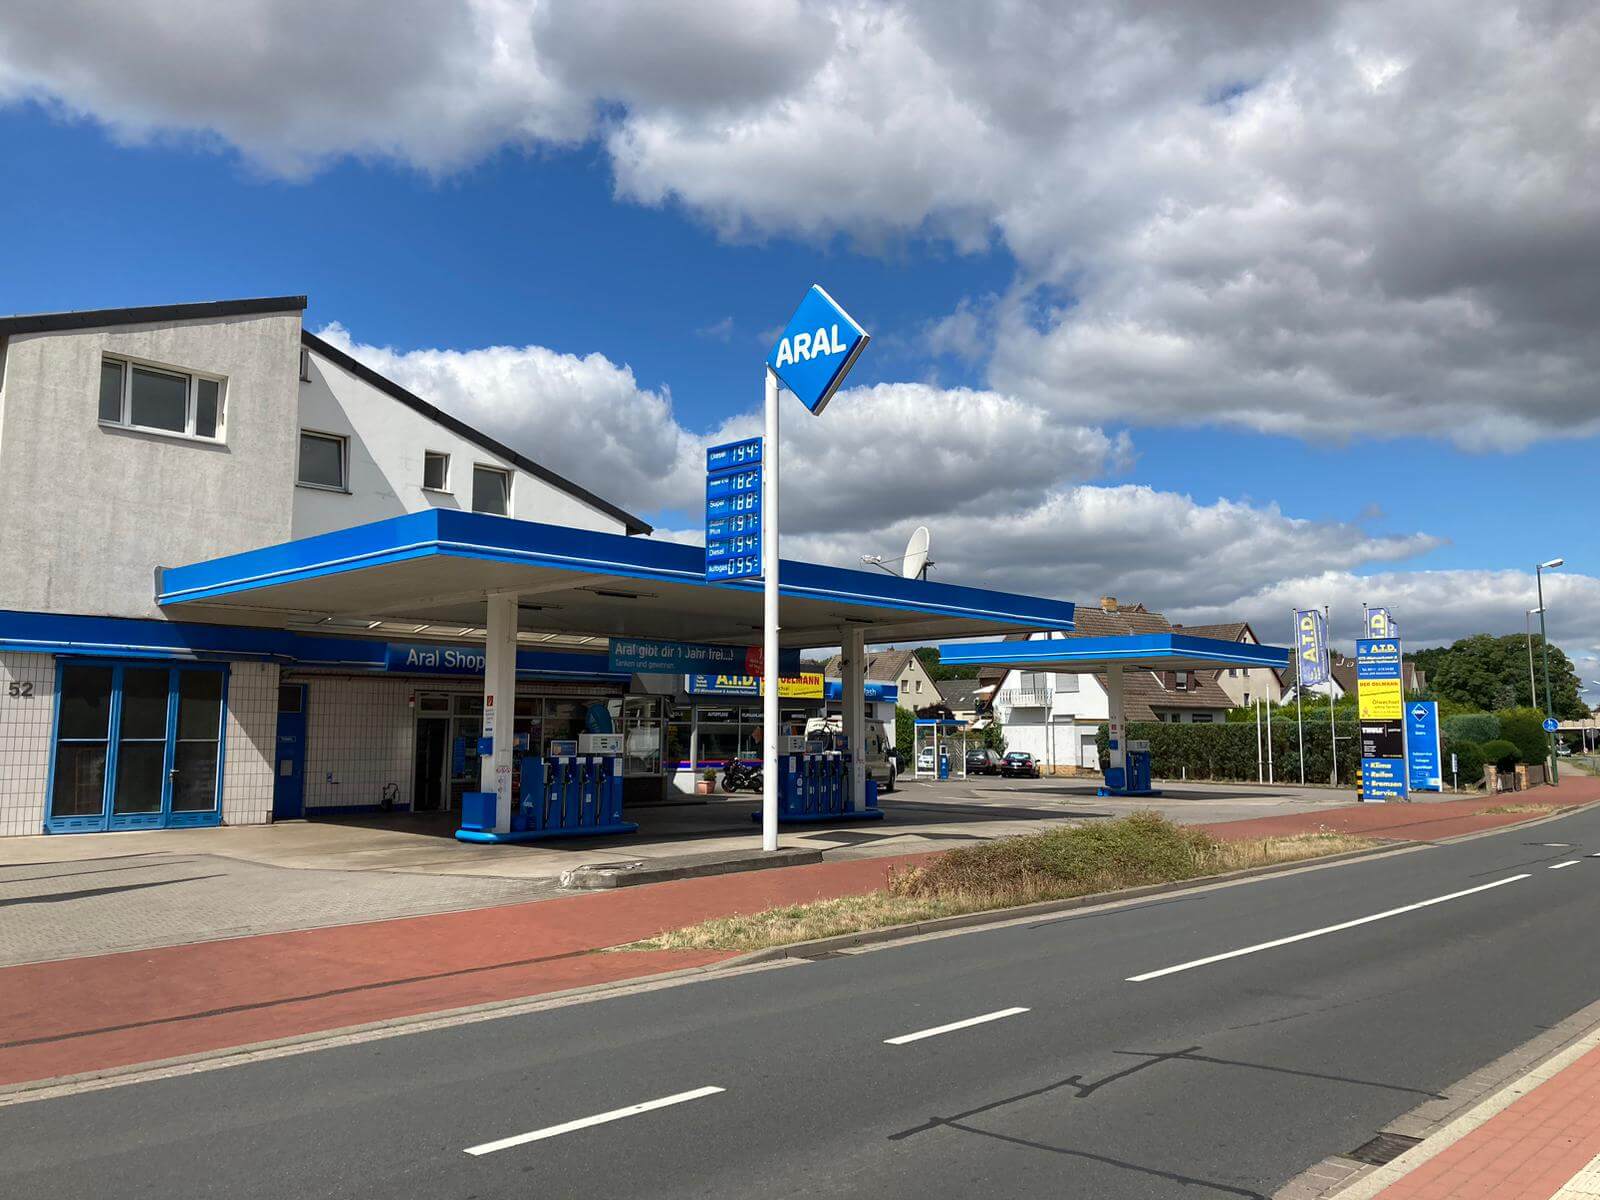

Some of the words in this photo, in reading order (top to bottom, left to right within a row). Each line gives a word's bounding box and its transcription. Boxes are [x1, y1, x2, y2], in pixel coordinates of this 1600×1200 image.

[776, 324, 847, 368] ARAL
[709, 548, 725, 556] Diesel
[709, 563, 728, 573] Autogas
[639, 646, 659, 659] gibt
[661, 647, 675, 658] dir
[678, 648, 682, 657] 1
[685, 648, 707, 660] Jahr
[1370, 644, 1397, 653] A.T.D.
[406, 648, 440, 668] Aral
[444, 650, 485, 673] Shop
[635, 659, 648, 669] und
[8, 682, 33, 697] 52
[1370, 770, 1394, 778] Reifen
[1372, 789, 1398, 797] Service
